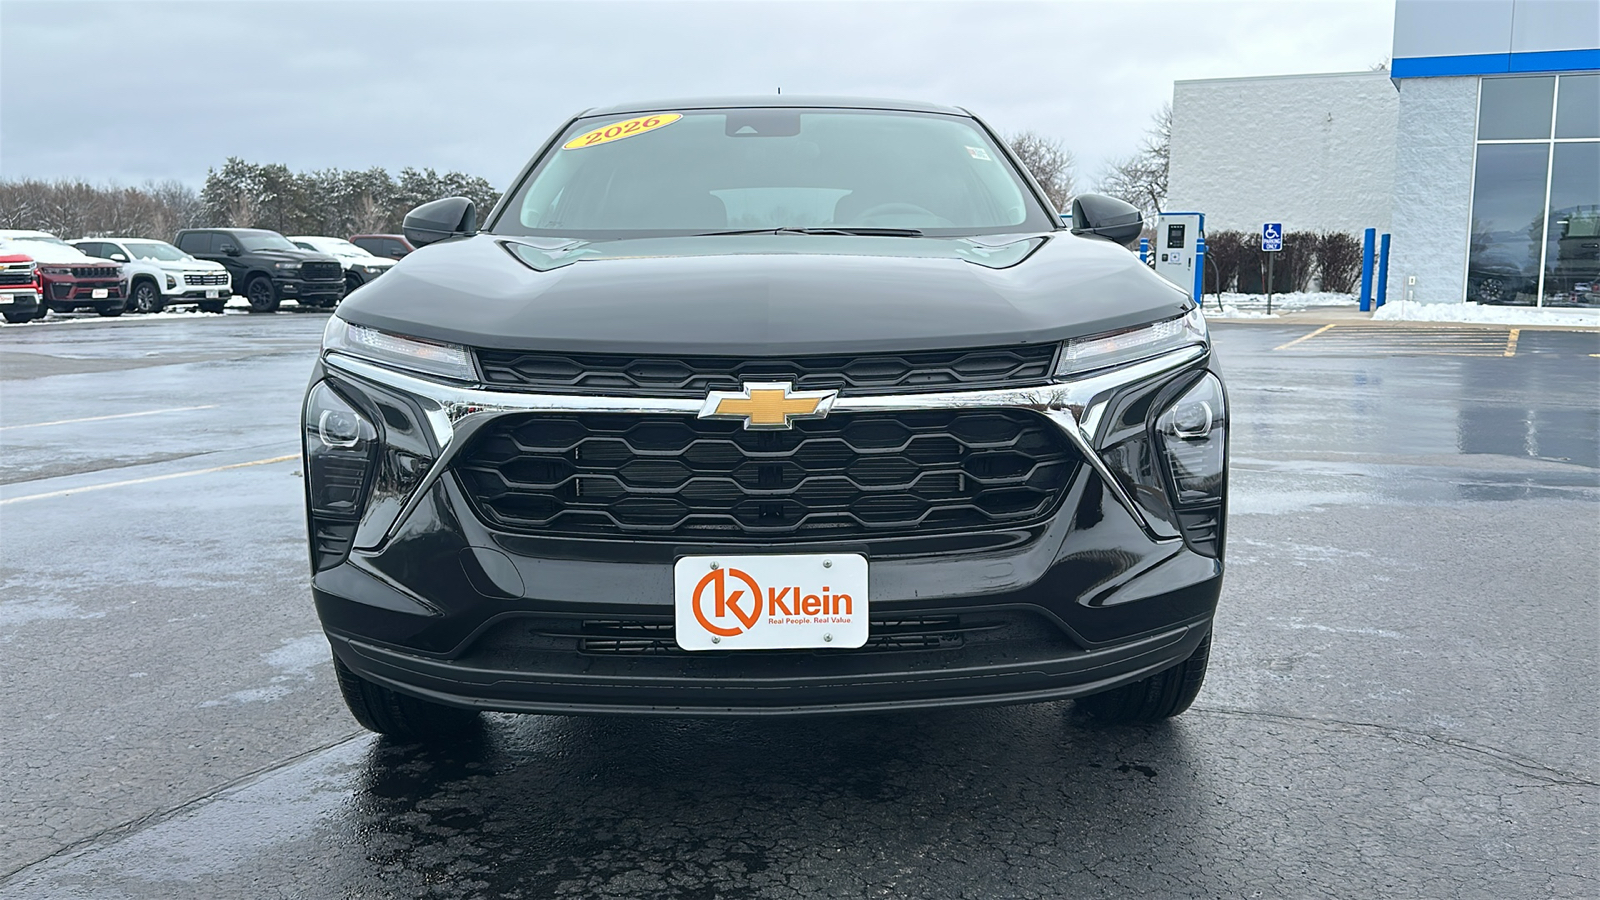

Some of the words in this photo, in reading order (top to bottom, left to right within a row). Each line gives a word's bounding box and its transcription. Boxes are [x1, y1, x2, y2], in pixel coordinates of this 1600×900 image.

[585, 115, 661, 145] 2026
[768, 586, 853, 616] Klein
[768, 617, 784, 625] Real
[785, 617, 812, 625] People.
[813, 616, 830, 624] Real
[831, 616, 853, 624] Value.
